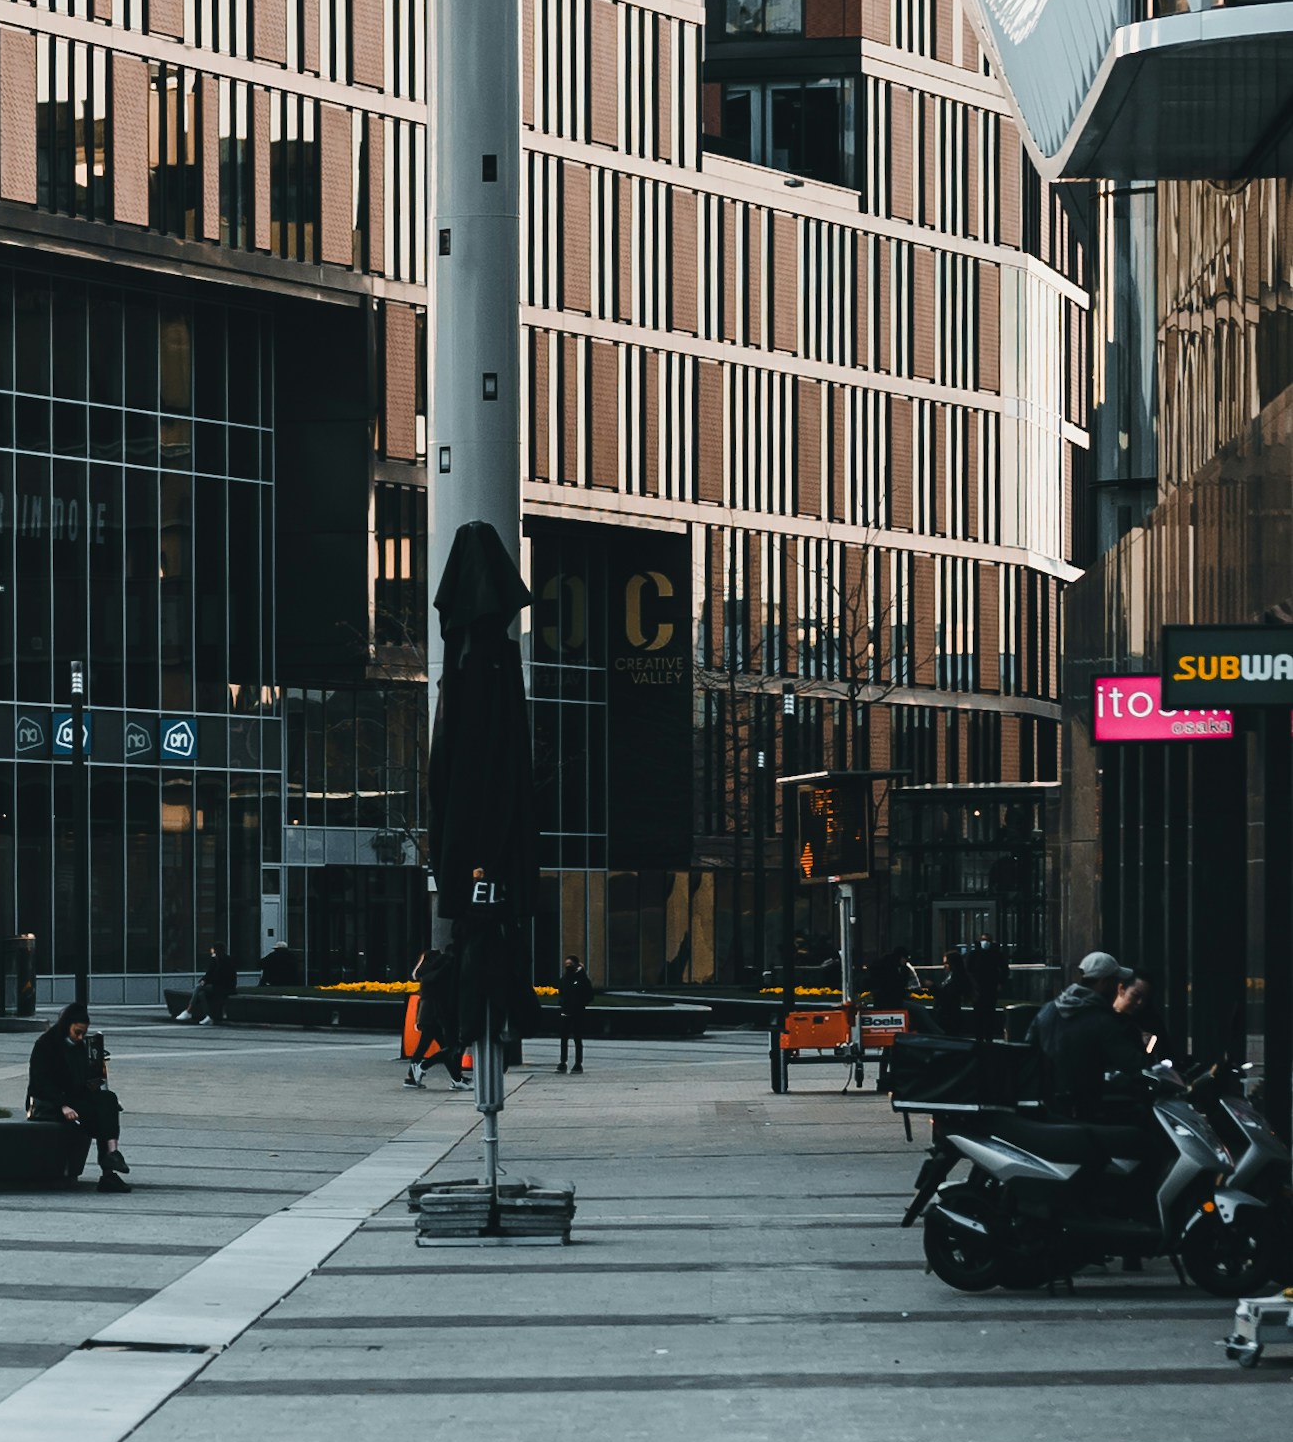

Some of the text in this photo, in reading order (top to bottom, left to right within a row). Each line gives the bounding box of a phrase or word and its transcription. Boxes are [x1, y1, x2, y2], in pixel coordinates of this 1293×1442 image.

[615, 656, 684, 670] CREATIVE
[631, 671, 684, 685] VALLEY
[1172, 718, 1232, 736] osaka
[861, 1016, 903, 1027] Boels
